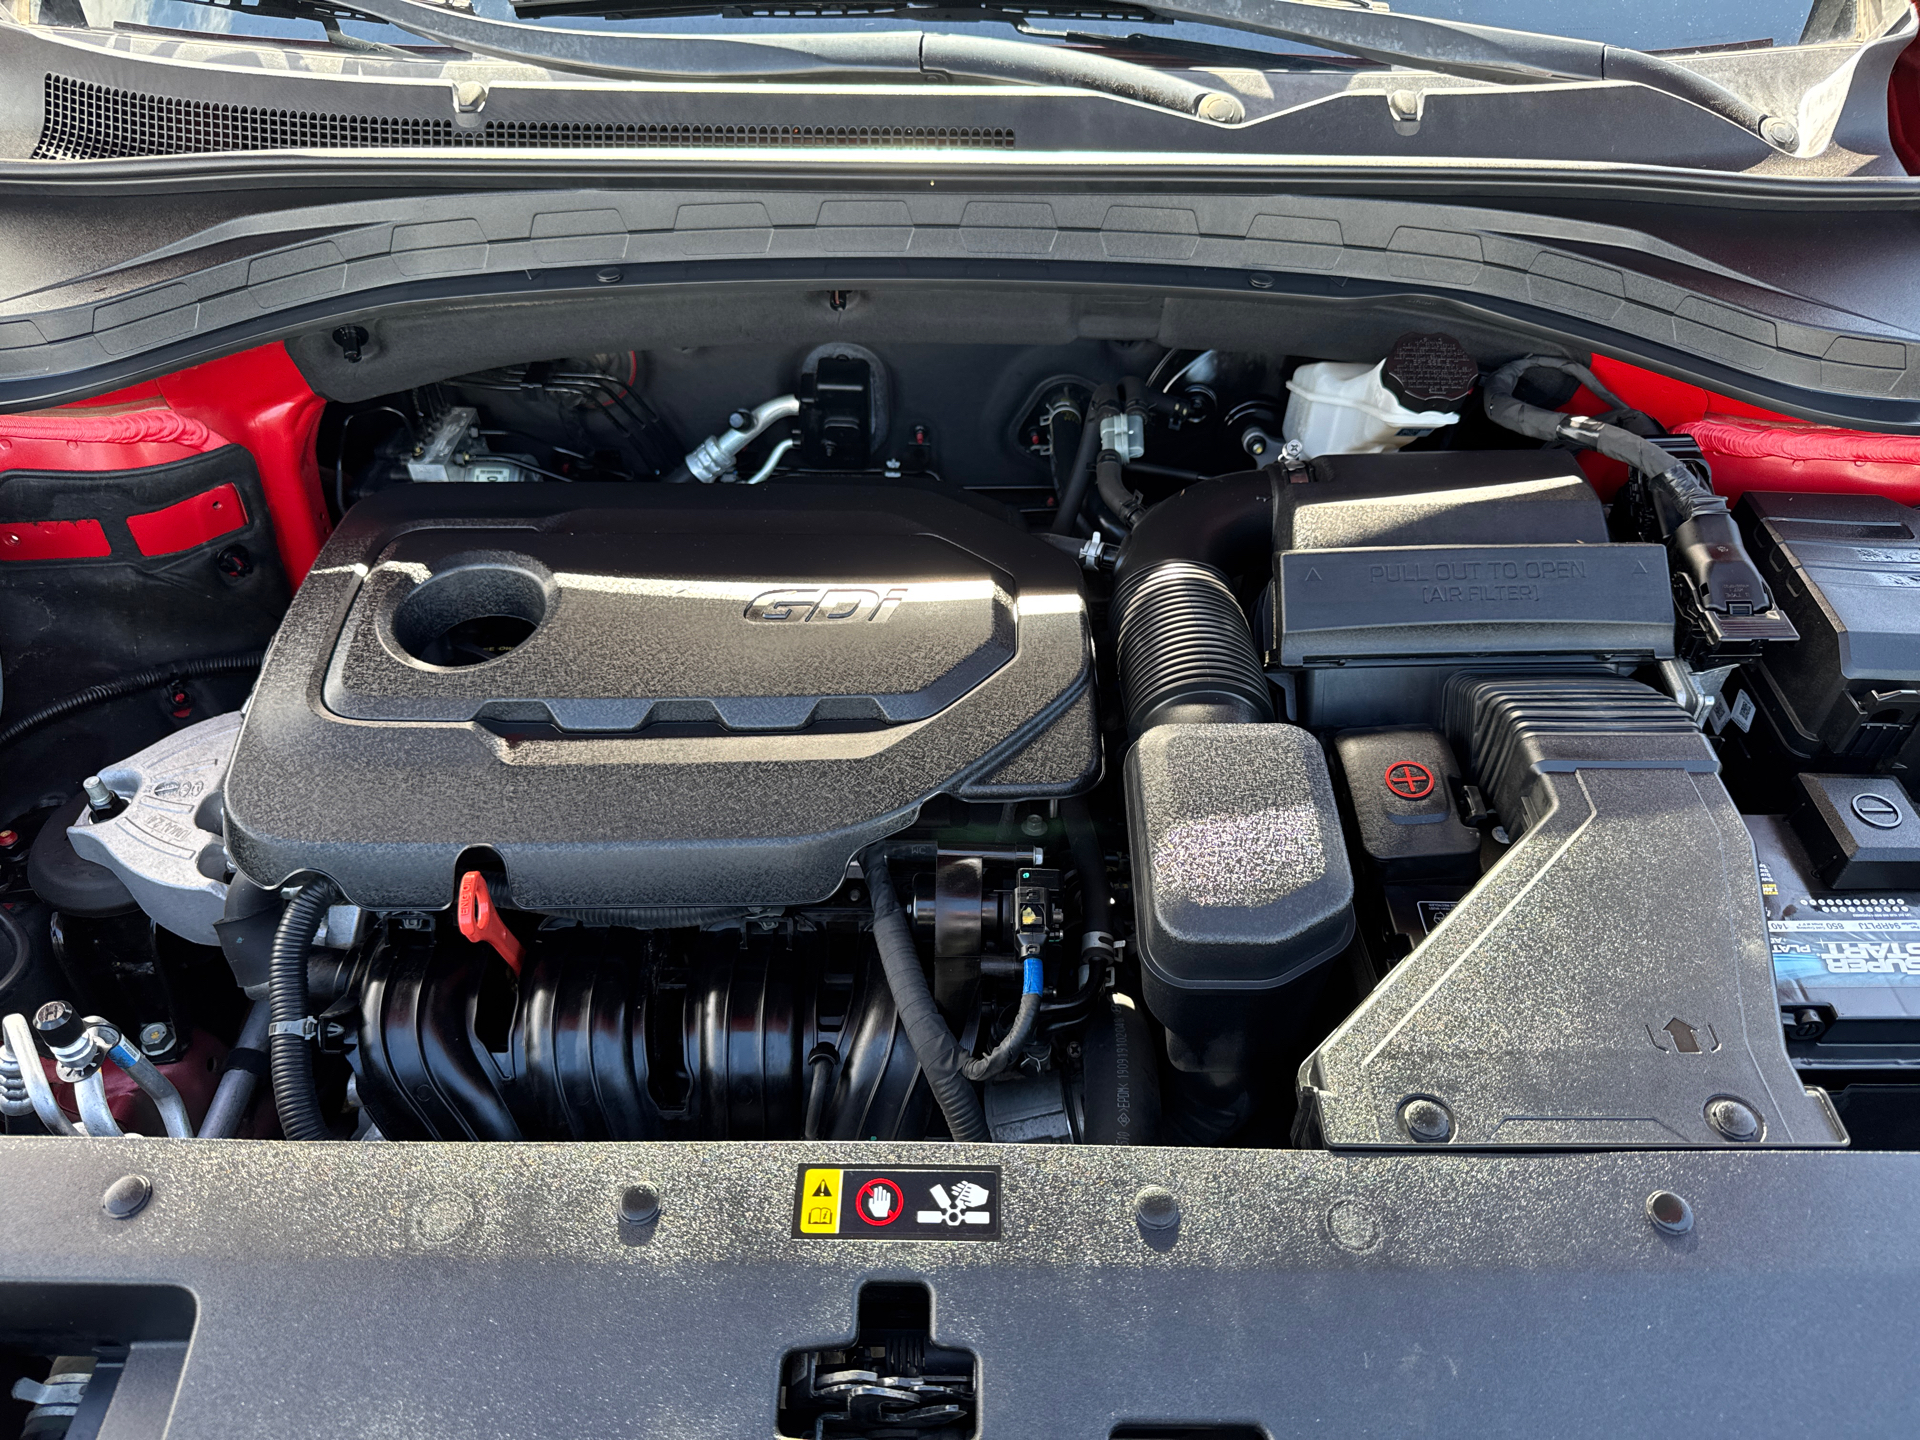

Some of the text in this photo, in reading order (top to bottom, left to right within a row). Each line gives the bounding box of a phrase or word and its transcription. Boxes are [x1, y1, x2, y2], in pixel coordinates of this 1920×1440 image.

[1369, 559, 1586, 583] PULL OUT TO OPEN
[461, 878, 472, 916] ENG OIL
[1770, 922, 1789, 930] 140
[1826, 922, 1845, 930] 850
[1821, 942, 1920, 959] START
[1825, 958, 1920, 975] SUPER
